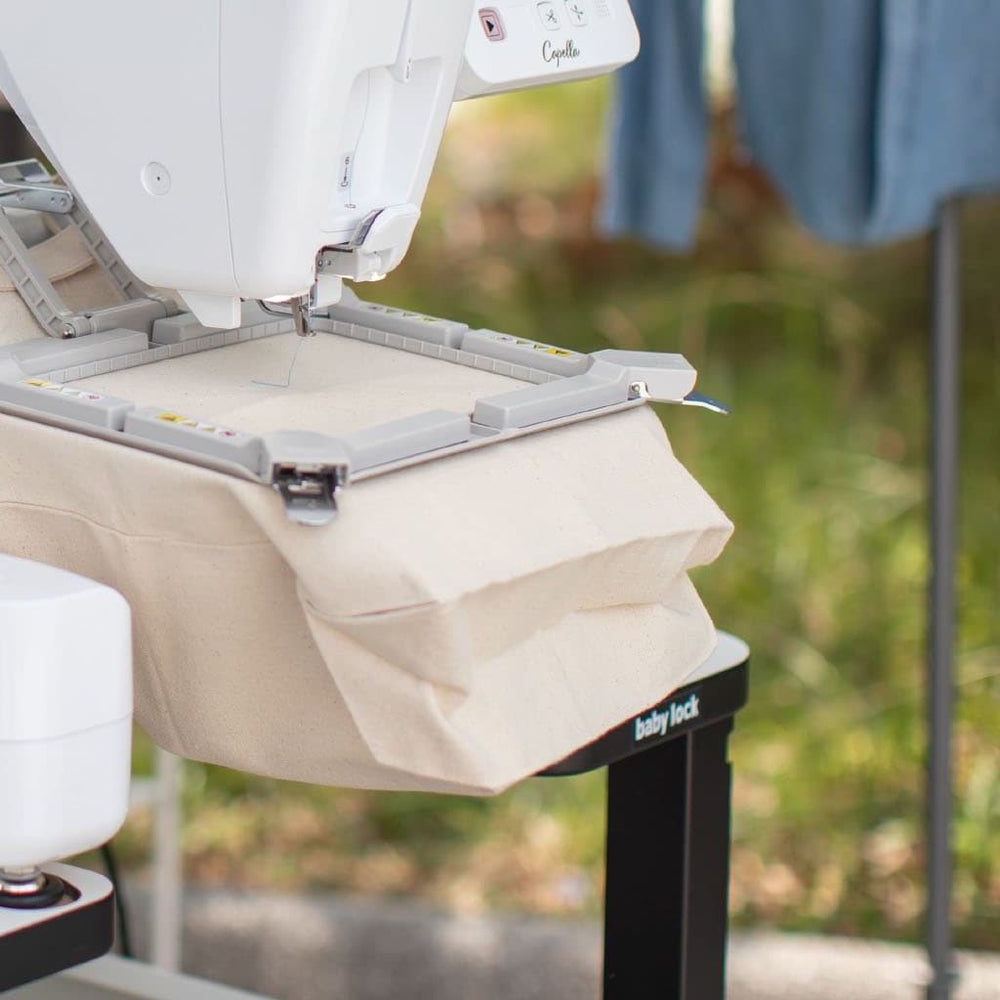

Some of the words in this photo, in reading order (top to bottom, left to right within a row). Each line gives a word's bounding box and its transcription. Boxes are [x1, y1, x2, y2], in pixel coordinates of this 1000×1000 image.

[542, 39, 580, 68] Capella
[635, 711, 669, 741] baby
[670, 694, 699, 727] lock
